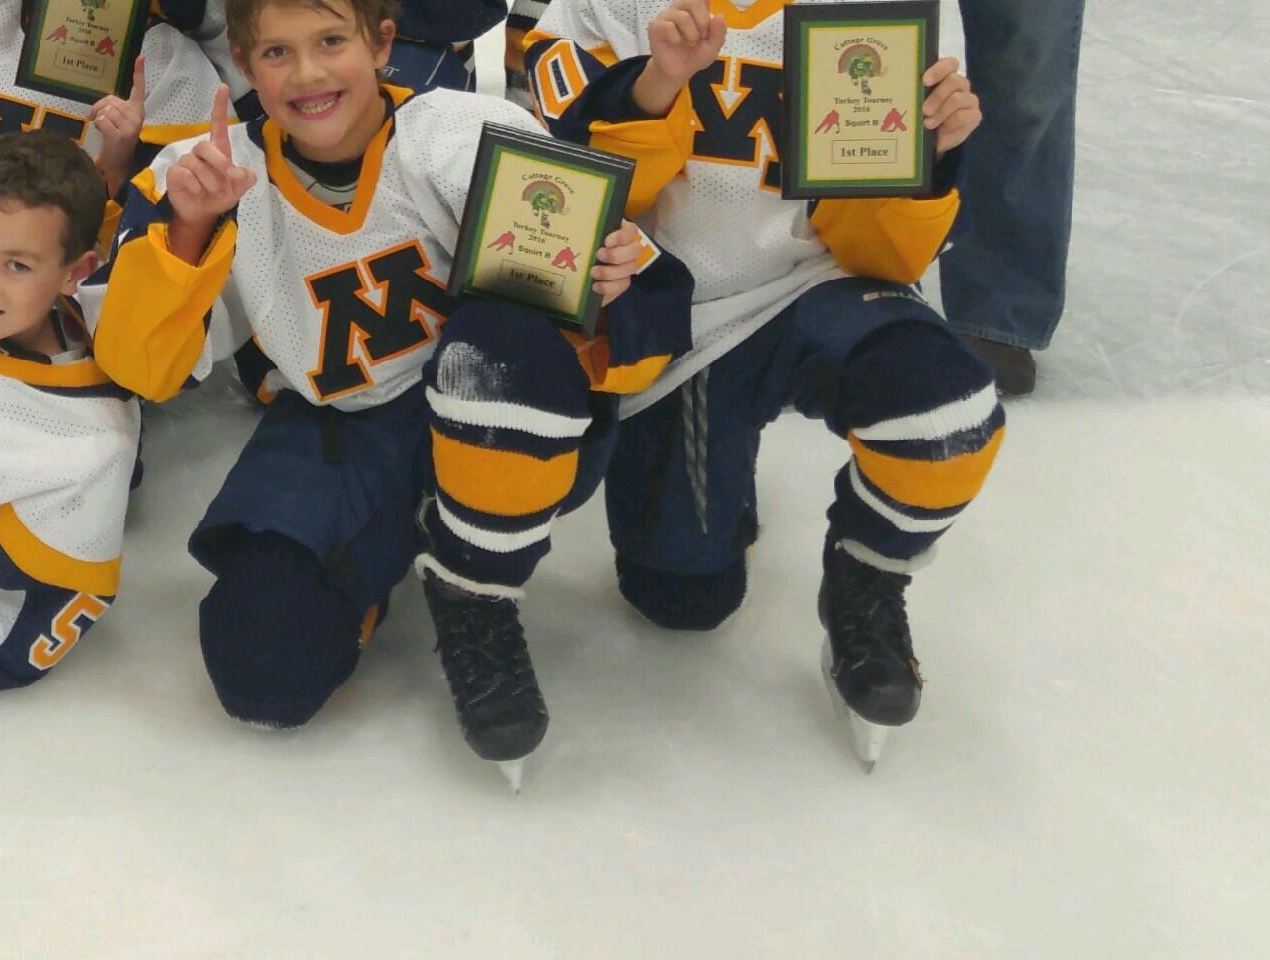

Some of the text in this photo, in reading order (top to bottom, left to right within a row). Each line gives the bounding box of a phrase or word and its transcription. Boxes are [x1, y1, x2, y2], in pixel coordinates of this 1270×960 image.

[834, 37, 889, 51] Cottage Grove
[62, 56, 98, 72] 1st Place
[834, 97, 860, 105] Turkey
[845, 119, 870, 128] Squirt
[841, 147, 889, 157] 1st Place
[522, 172, 575, 194] Cottage Grove
[513, 221, 569, 243] Turkey Tourney
[528, 235, 546, 244] 2016
[518, 245, 542, 257] Squirt
[509, 269, 555, 288] 1st Place
[304, 239, 451, 402] M
[29, 590, 112, 672] 5
